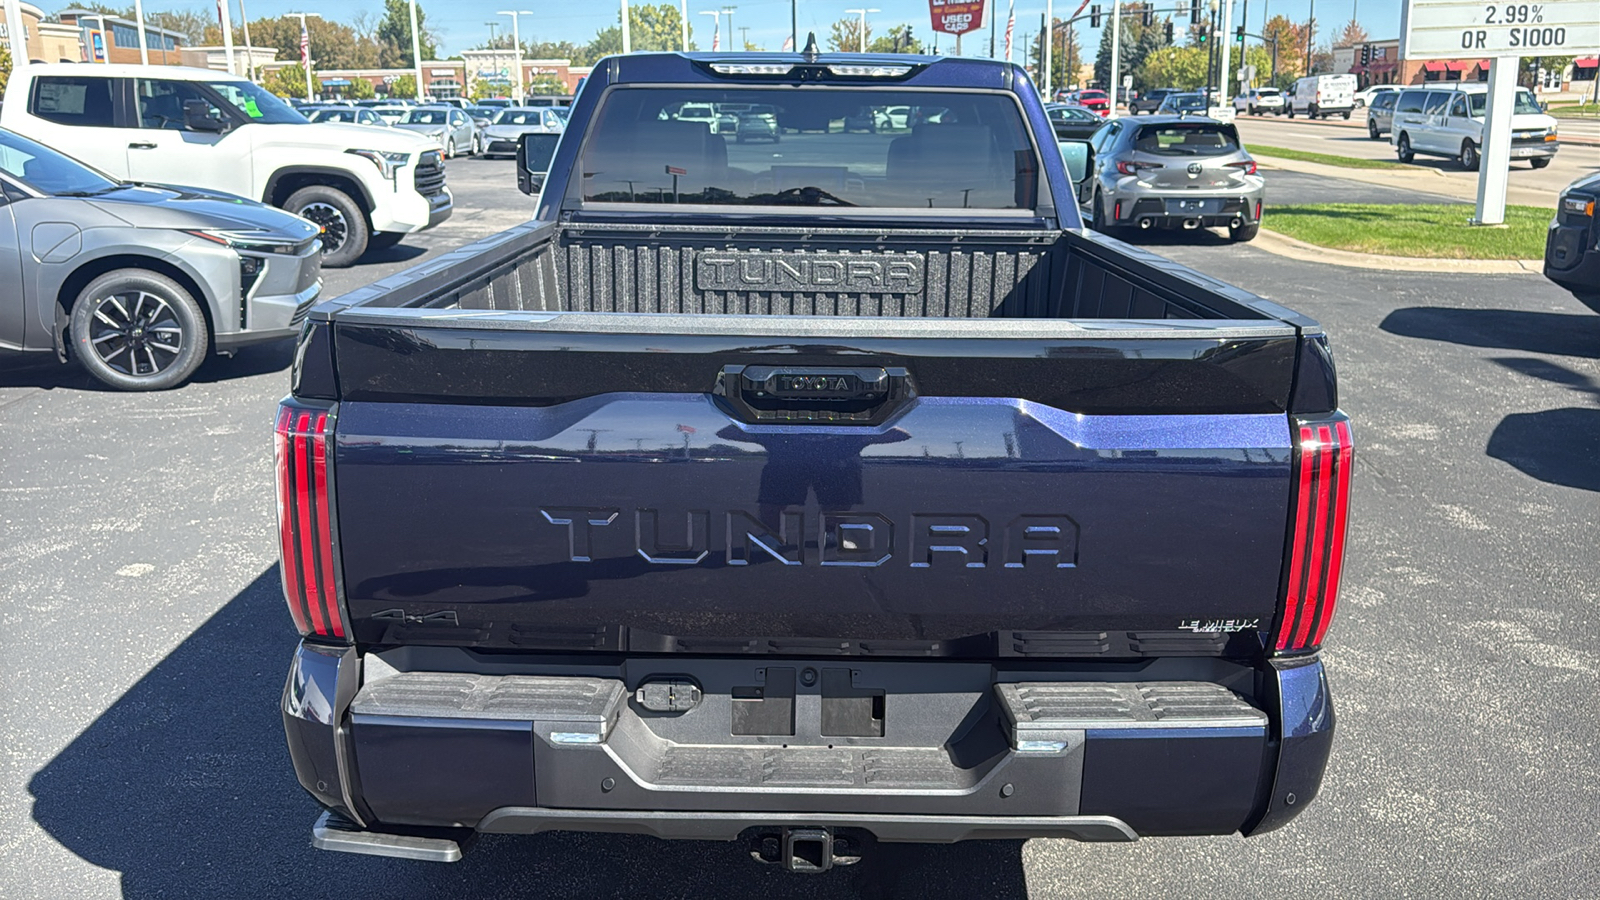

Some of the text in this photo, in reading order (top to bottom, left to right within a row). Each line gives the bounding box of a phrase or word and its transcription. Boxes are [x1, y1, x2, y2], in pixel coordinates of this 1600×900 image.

[941, 13, 973, 24] USED
[1485, 5, 1543, 24] 2.99%
[944, 23, 969, 32] CARS
[1461, 30, 1487, 48] OR
[704, 258, 919, 286] TUNDRA
[781, 376, 849, 390] TOYOTA
[540, 506, 1081, 569] TUNDRA
